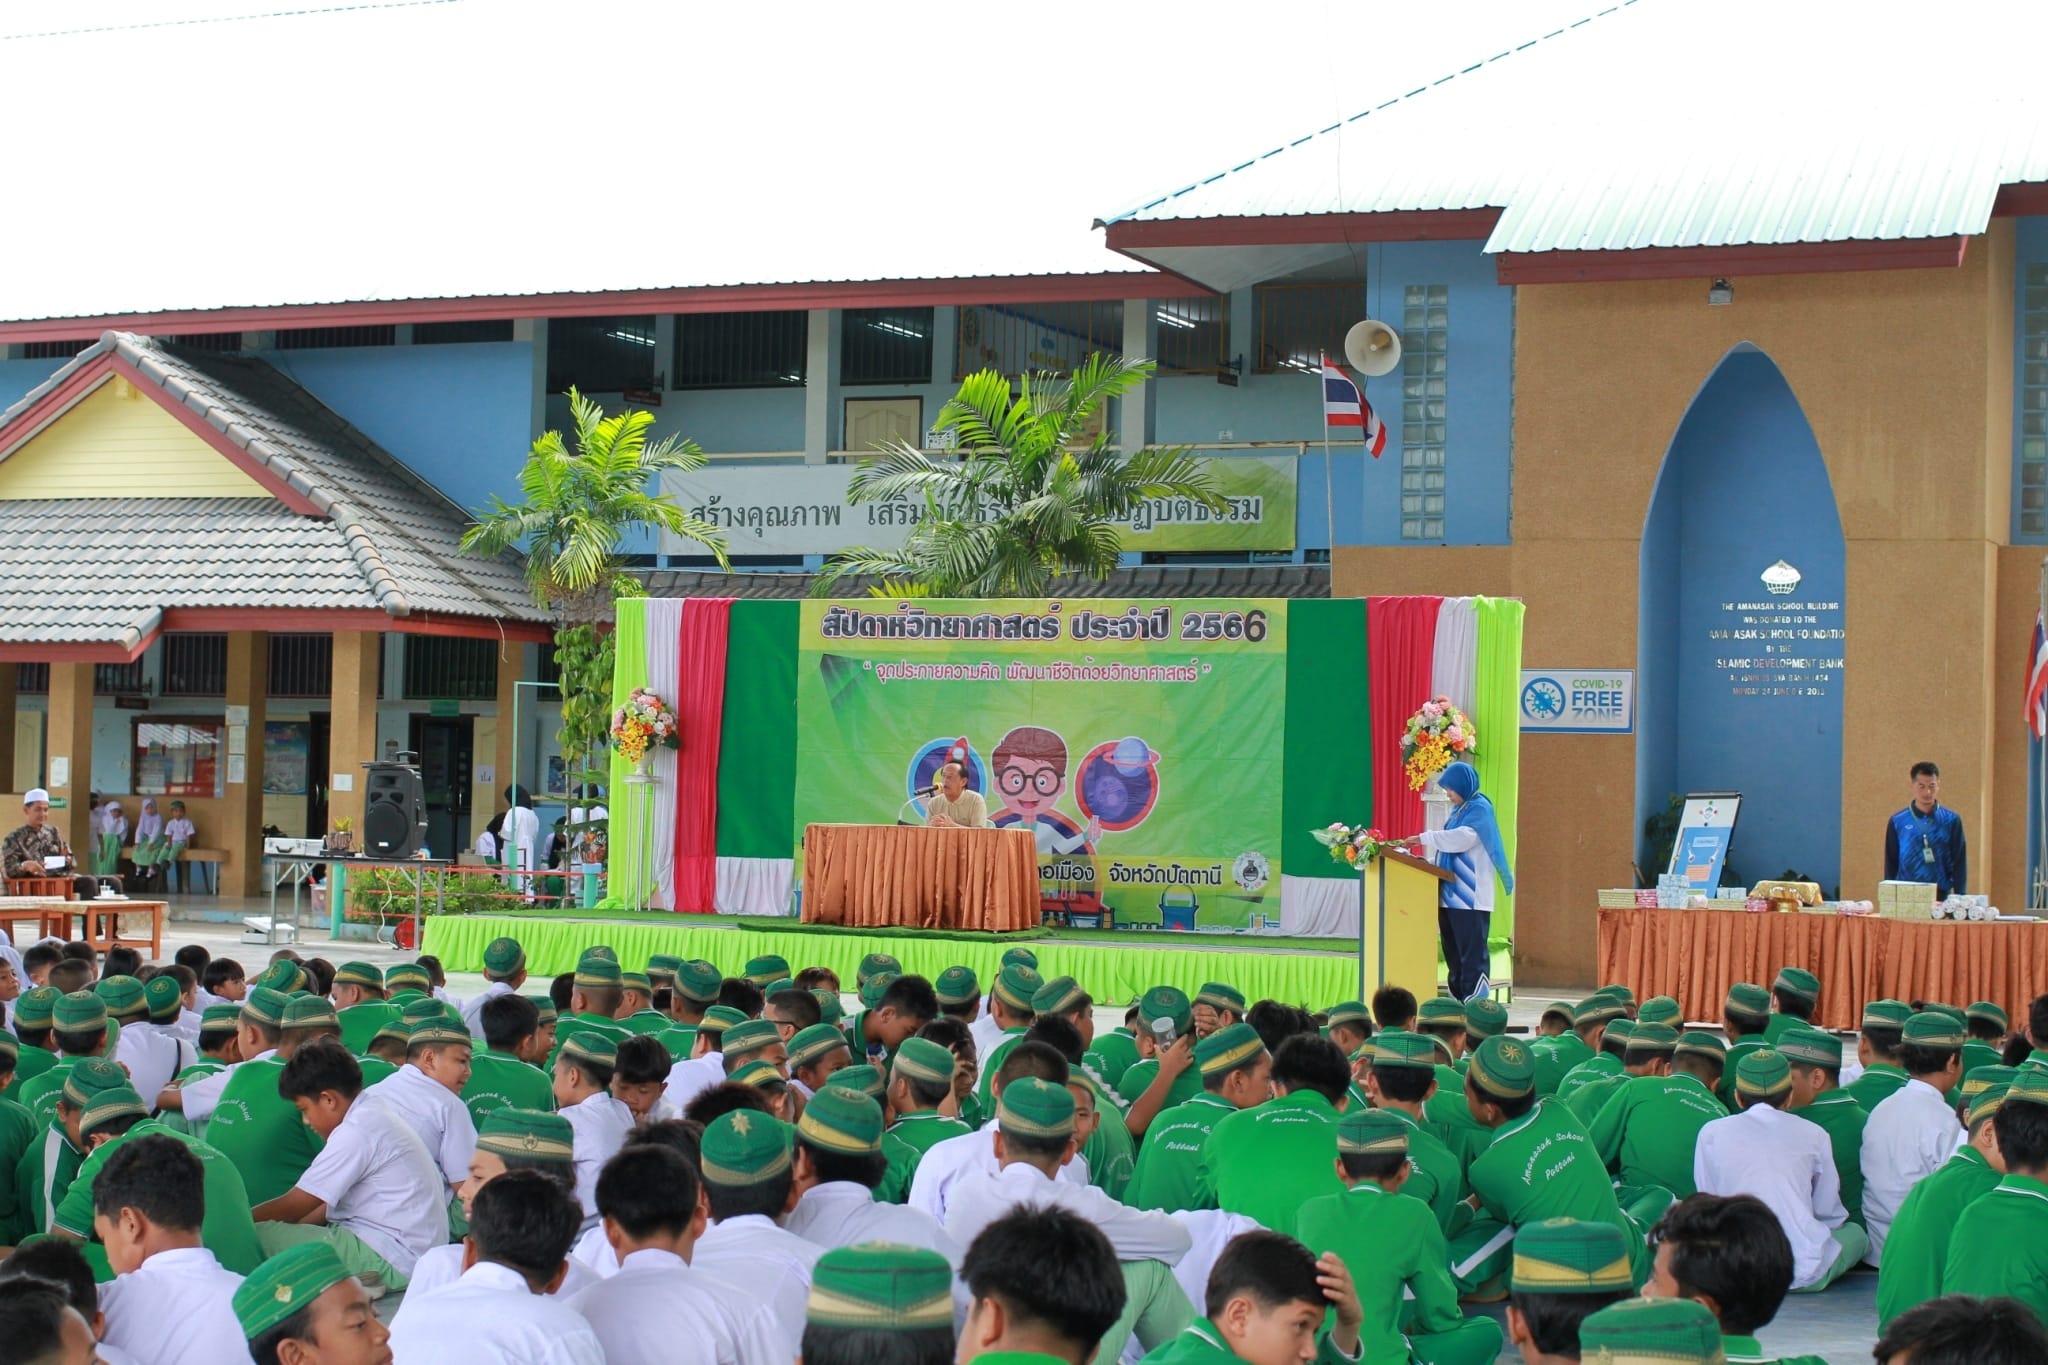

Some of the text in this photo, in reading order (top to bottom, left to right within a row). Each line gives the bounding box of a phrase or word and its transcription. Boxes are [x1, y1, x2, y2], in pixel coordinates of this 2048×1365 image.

[689, 495, 841, 538] สร้างคุณภาพ
[1777, 602, 1805, 611] SCHOOL
[821, 602, 1267, 642] สัปดาห์วิทยาศาสตร์ ประจำปี 2566
[1804, 616, 1817, 625] THE
[1709, 629, 1758, 640] AMAASAK
[1797, 629, 1845, 640] FOUNDATIO
[1572, 679, 1623, 689] COVID-19
[1571, 690, 1623, 707] FREE
[1571, 708, 1623, 722] ZONE
[1036, 859, 1096, 882] อเมือง
[1109, 861, 1222, 885] จังหวัดปัตตานี
